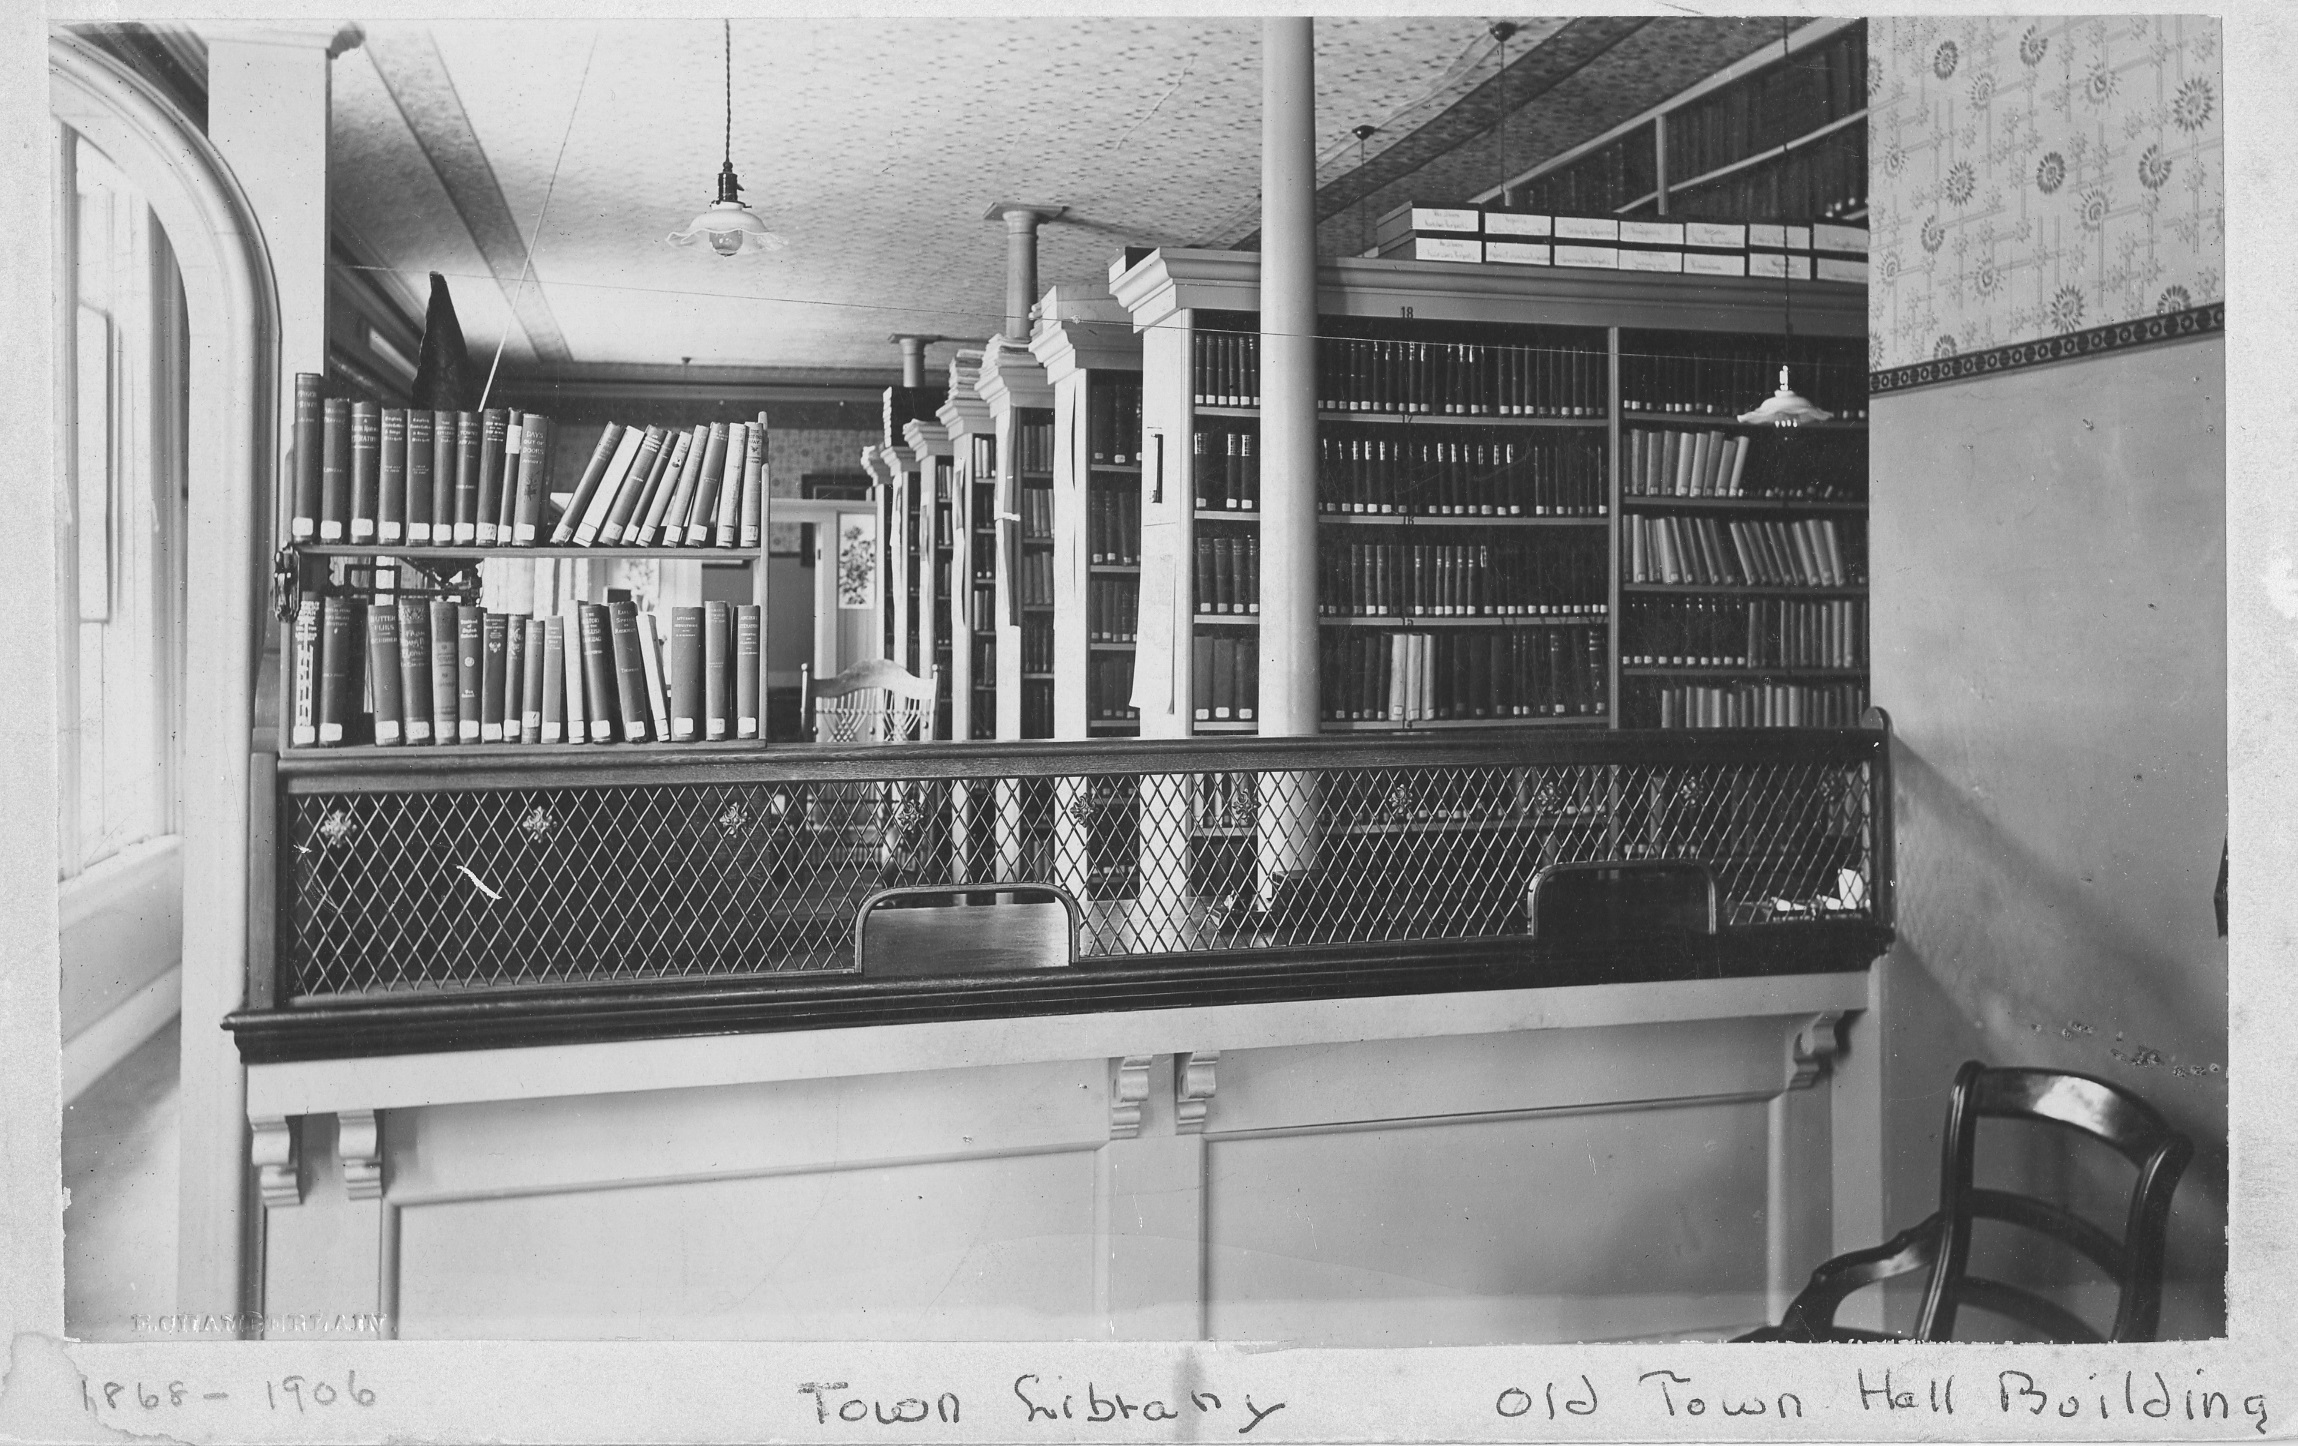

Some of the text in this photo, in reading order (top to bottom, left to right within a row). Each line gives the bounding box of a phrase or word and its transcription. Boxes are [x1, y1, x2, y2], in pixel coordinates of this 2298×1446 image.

[1401, 306, 1414, 319] 18
[526, 430, 544, 439] DAYS
[522, 446, 544, 455] DOORS
[266, 1369, 376, 1414] 1906
[796, 1373, 1287, 1434] Town Library
[1494, 1367, 2275, 1435] Old Town Hall Building
